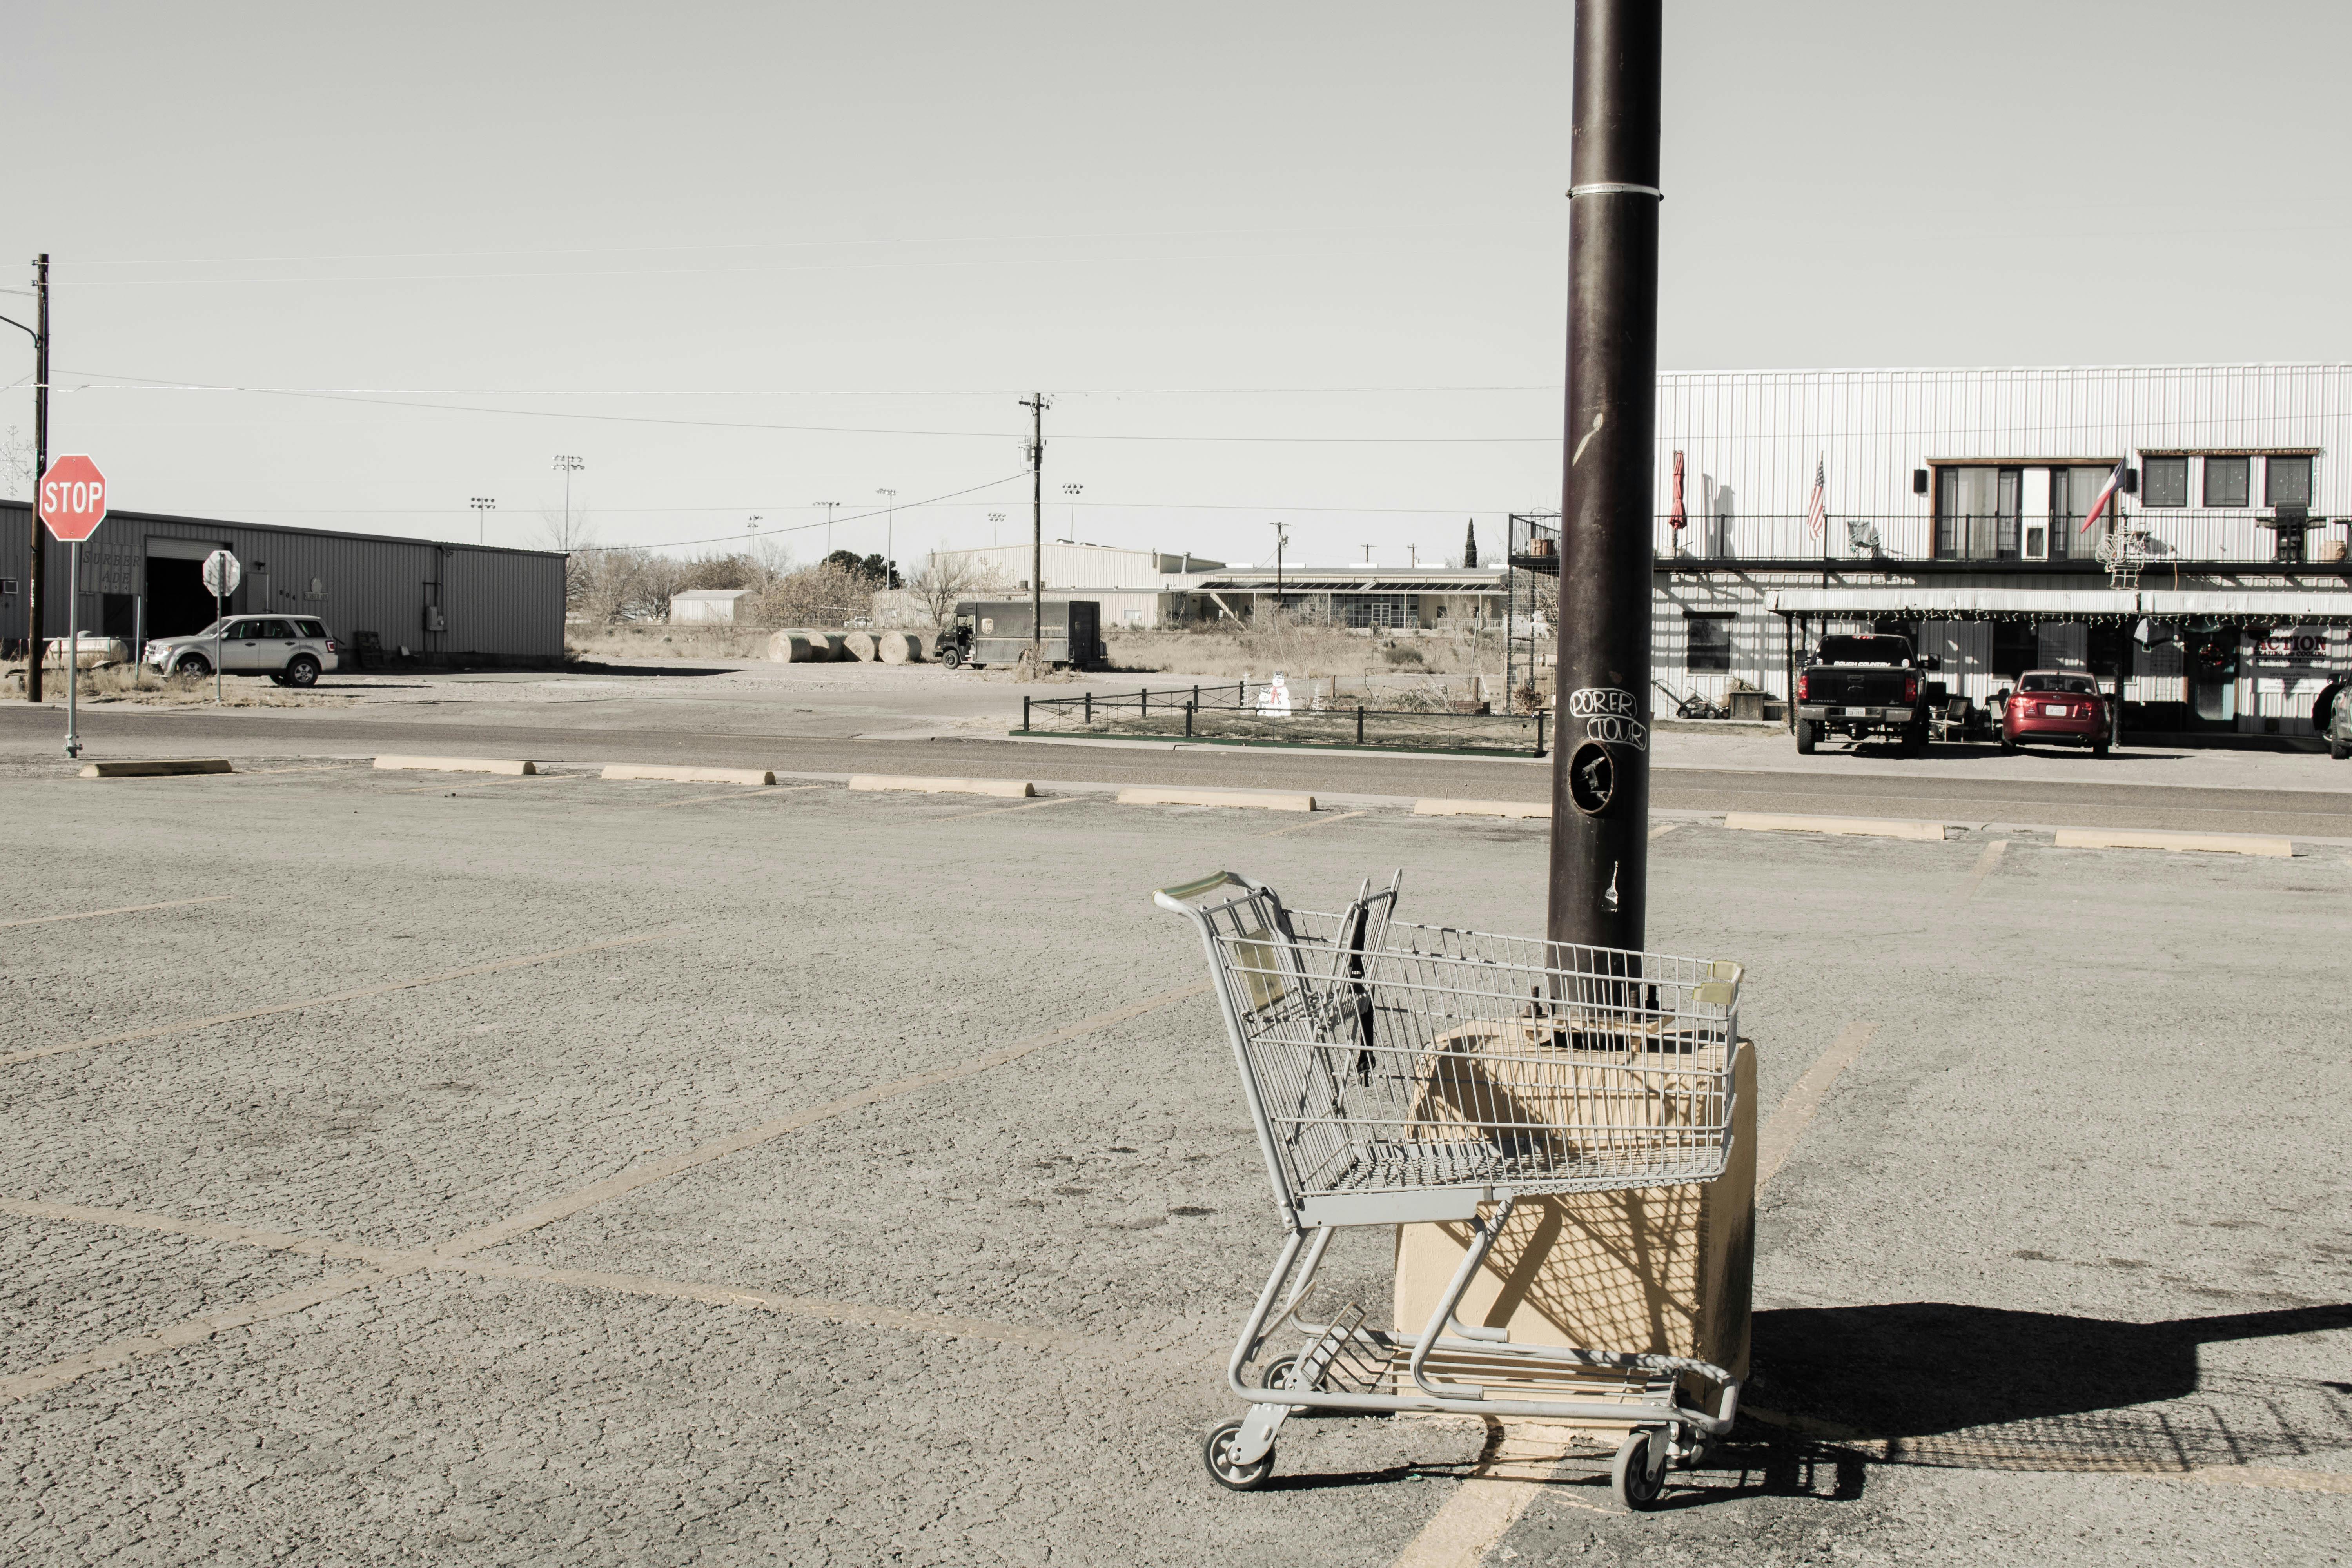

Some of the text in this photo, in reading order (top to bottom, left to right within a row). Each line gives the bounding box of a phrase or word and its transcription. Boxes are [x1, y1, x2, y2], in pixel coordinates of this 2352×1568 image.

[44, 481, 103, 513] STOP
[83, 550, 141, 567] SURBER
[102, 571, 131, 584] ADE
[279, 589, 296, 601] 804
[983, 622, 992, 632] ups
[2254, 635, 2327, 651] ACTION
[1591, 717, 1643, 747] TOUR
